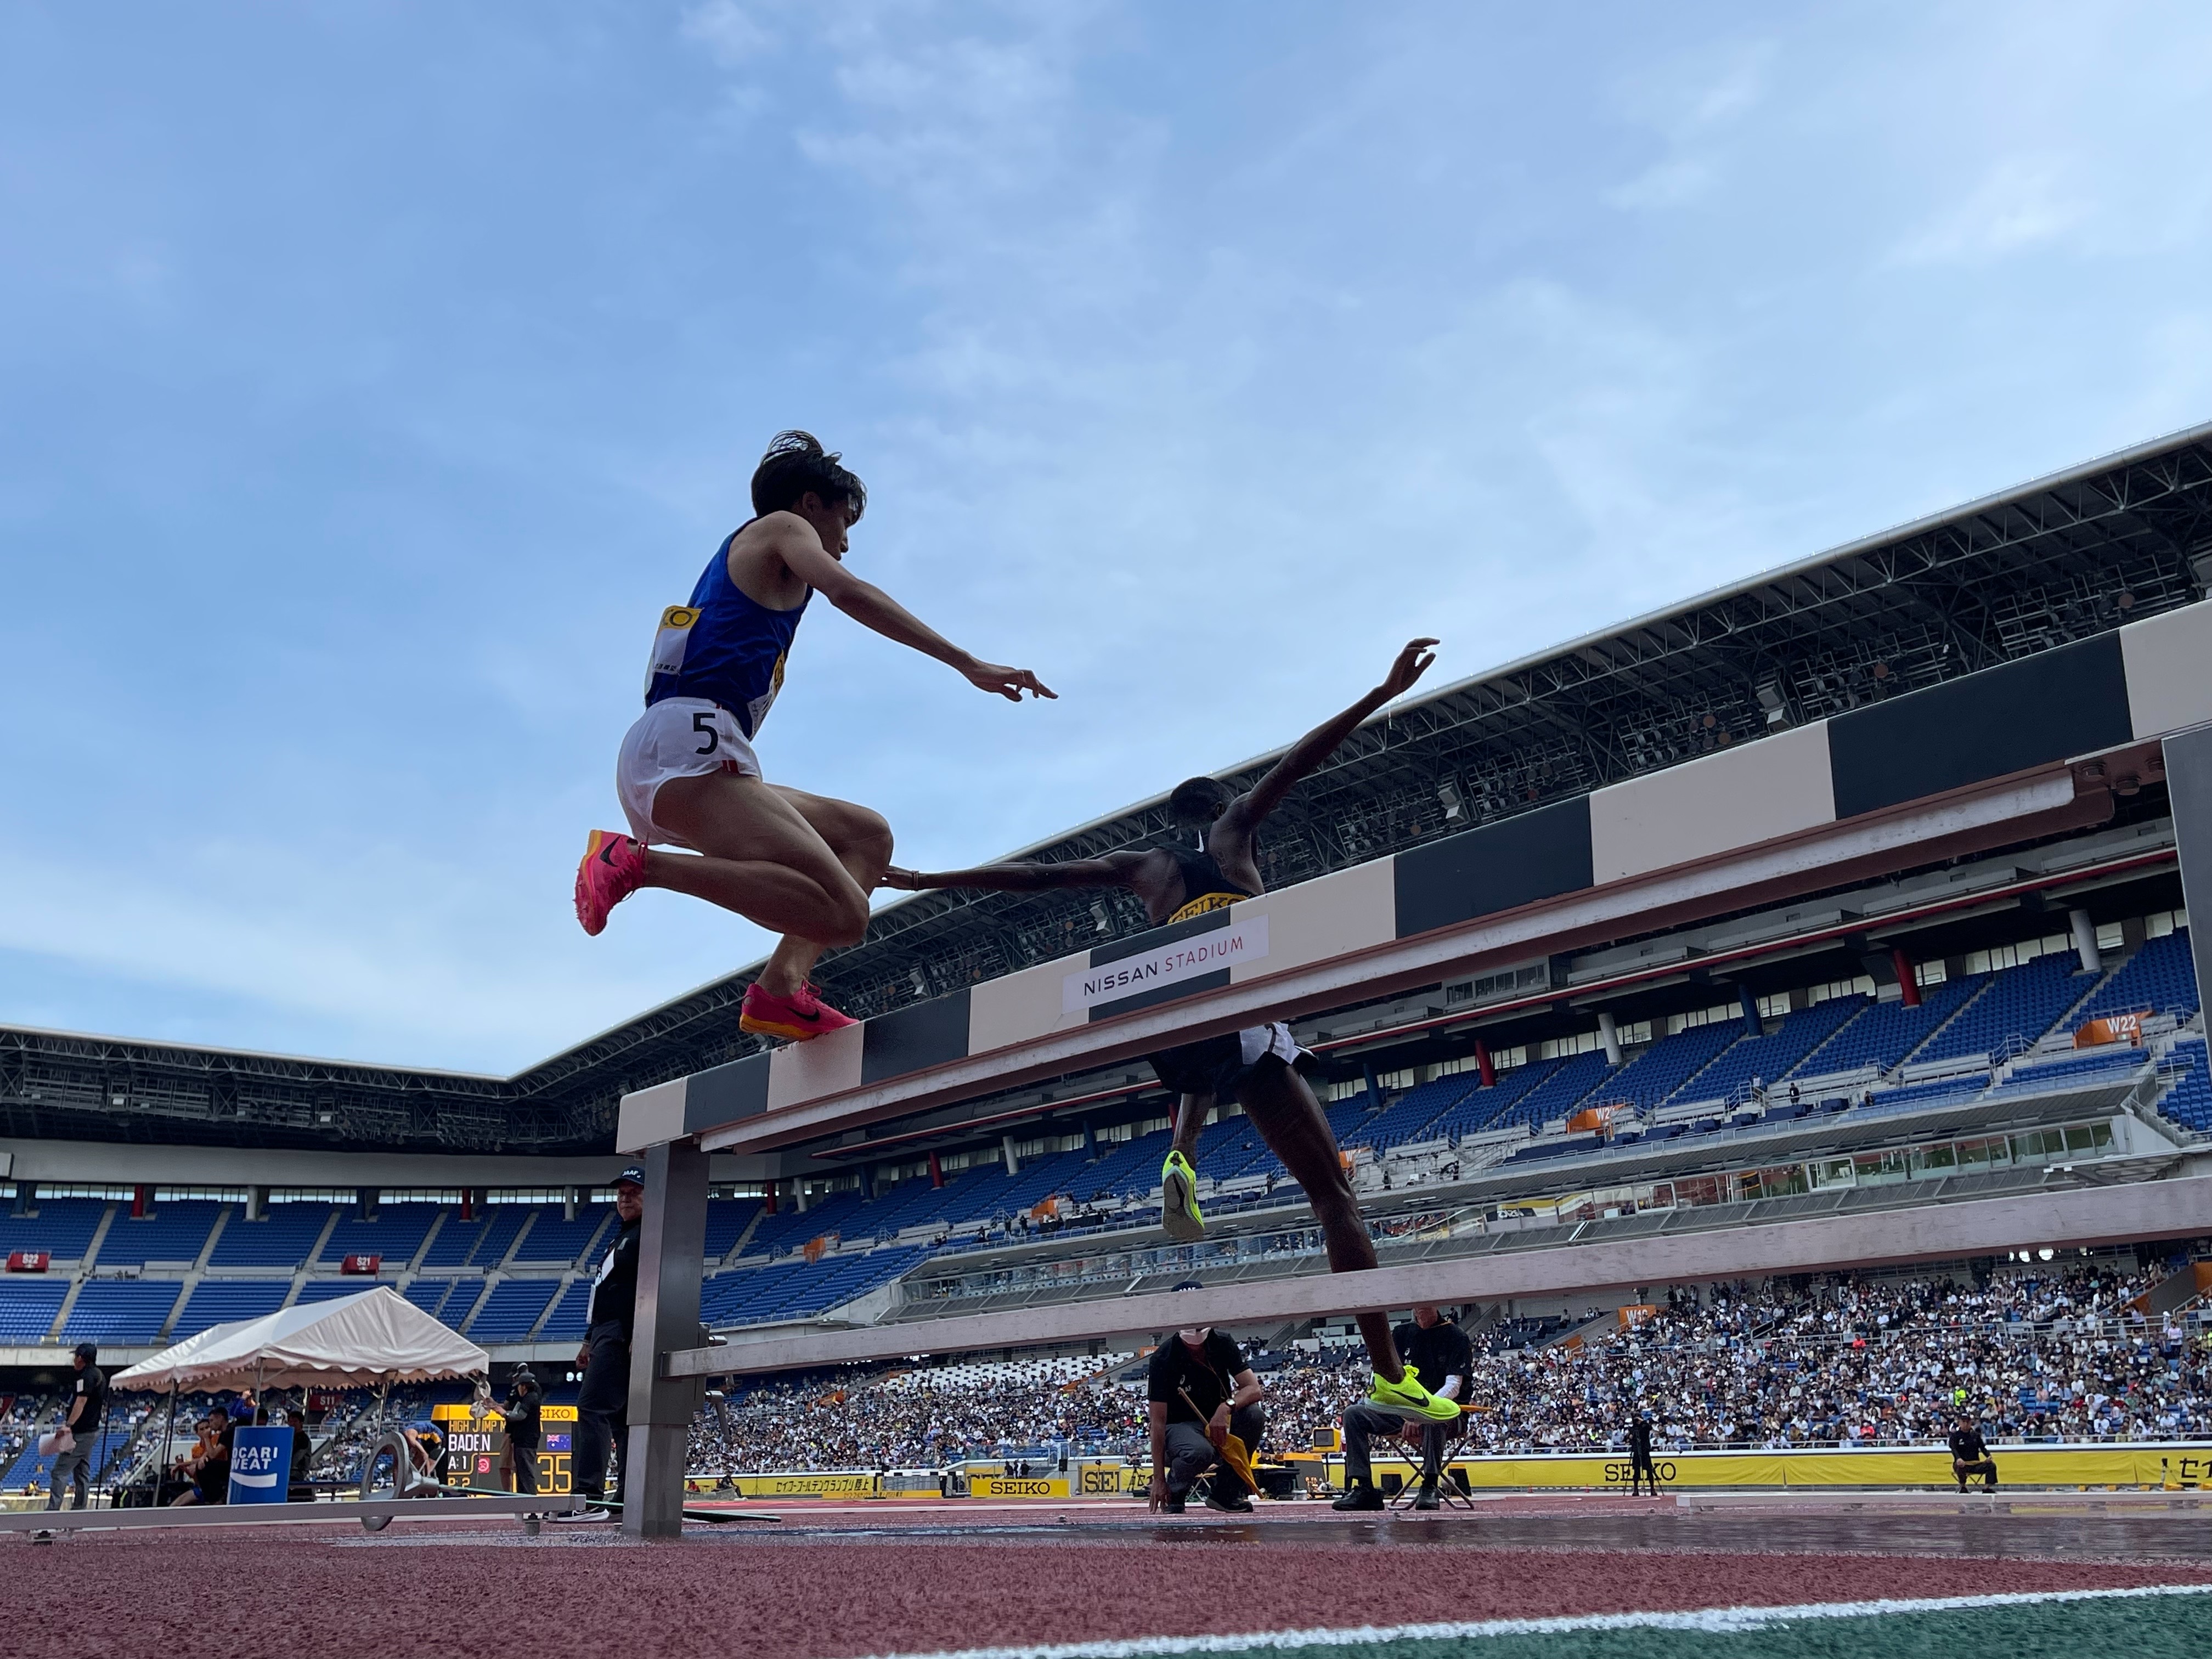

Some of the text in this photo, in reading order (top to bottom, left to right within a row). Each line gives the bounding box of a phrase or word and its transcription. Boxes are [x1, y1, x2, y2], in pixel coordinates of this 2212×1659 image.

[693, 712, 718, 755] 5
[1084, 936, 1243, 996] NISSAN STADIUM
[2107, 1015, 2137, 1034] W22
[22, 1253, 39, 1264] S22
[357, 1256, 371, 1266] S21
[320, 1396, 335, 1406] S11
[538, 1409, 570, 1419] EIKO
[449, 1420, 469, 1432] HIGH
[448, 1434, 490, 1452] BADEN
[1605, 1462, 1676, 1482] SEKO
[990, 1482, 1050, 1494] SEIKO
